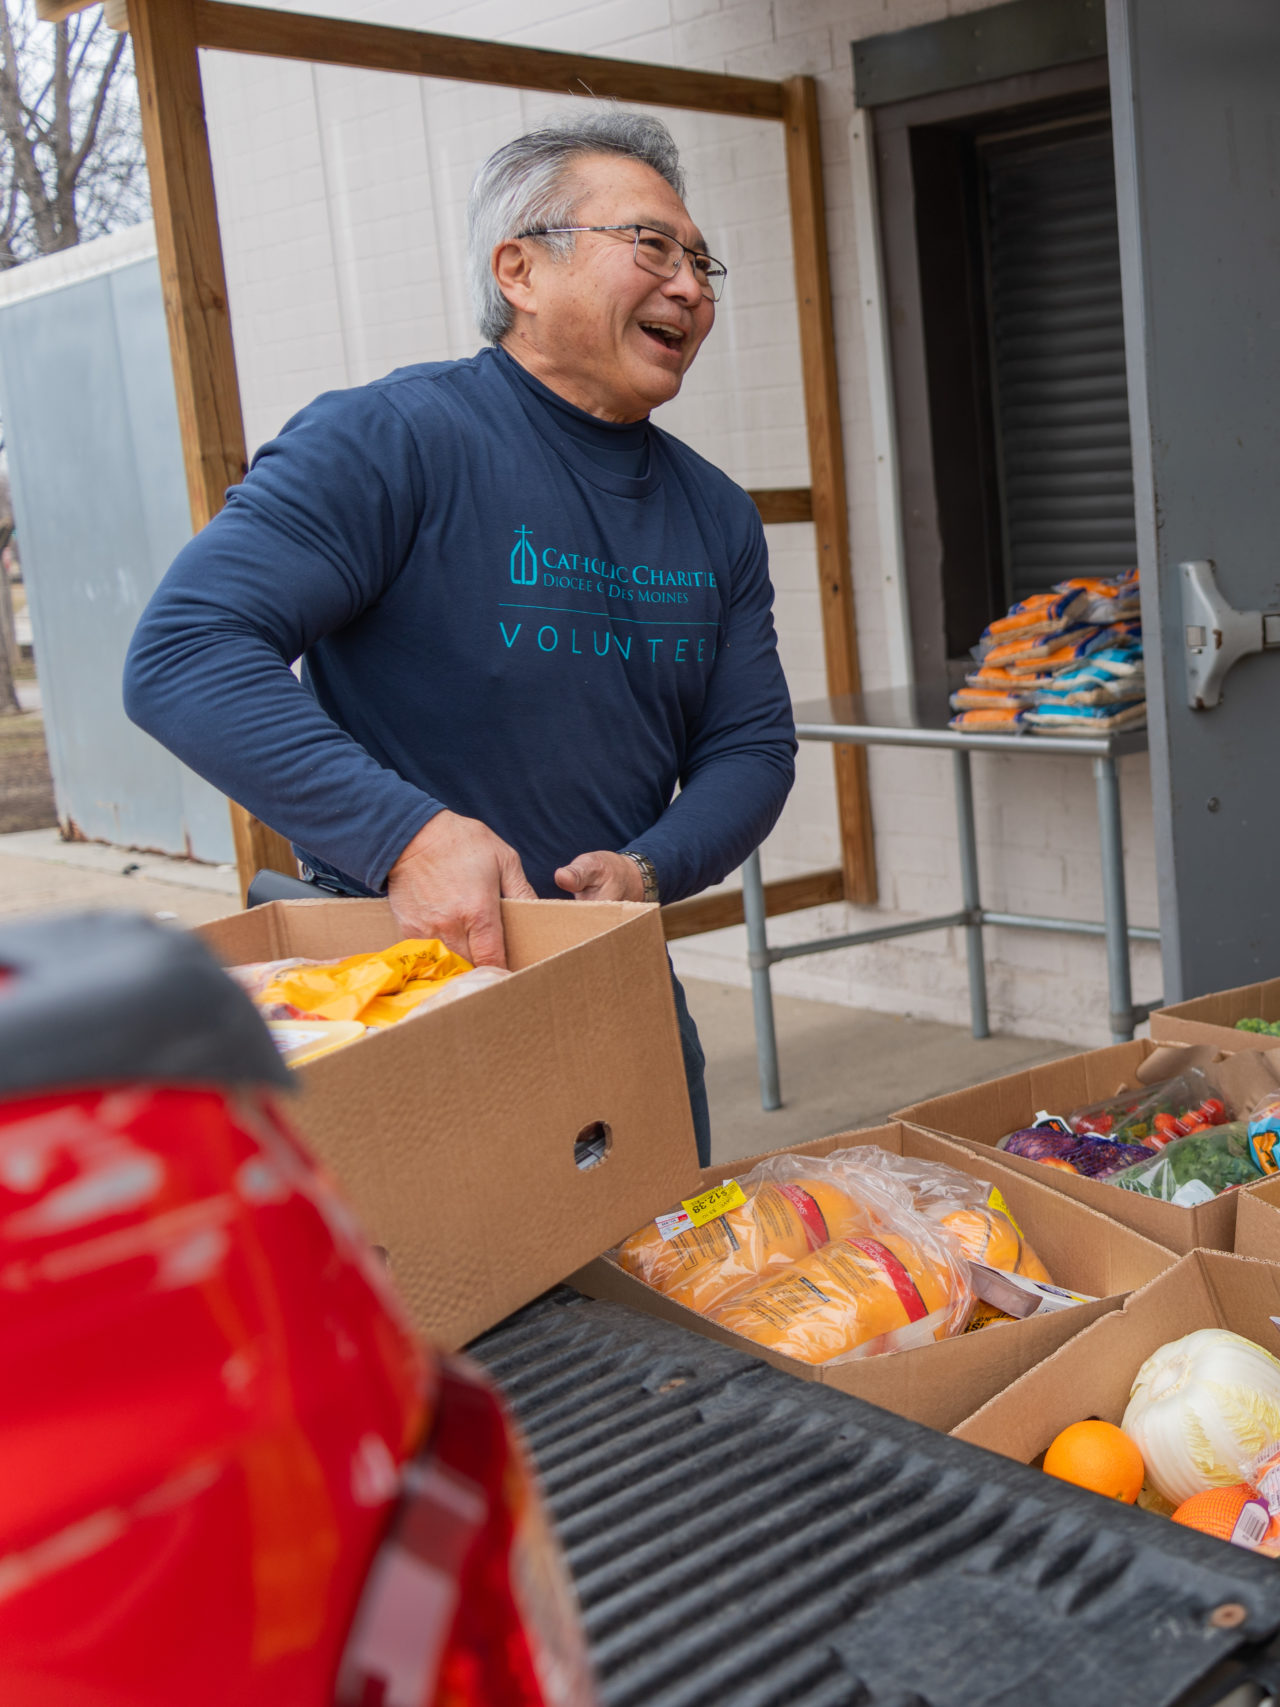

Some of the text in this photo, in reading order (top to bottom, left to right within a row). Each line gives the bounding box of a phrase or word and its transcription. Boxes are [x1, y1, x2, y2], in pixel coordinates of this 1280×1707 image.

[632, 565, 718, 588] CHARITIE
[638, 590, 689, 604] MOINES
[499, 622, 717, 663] VOLUNTEE
[692, 1190, 728, 1214] $12.38
